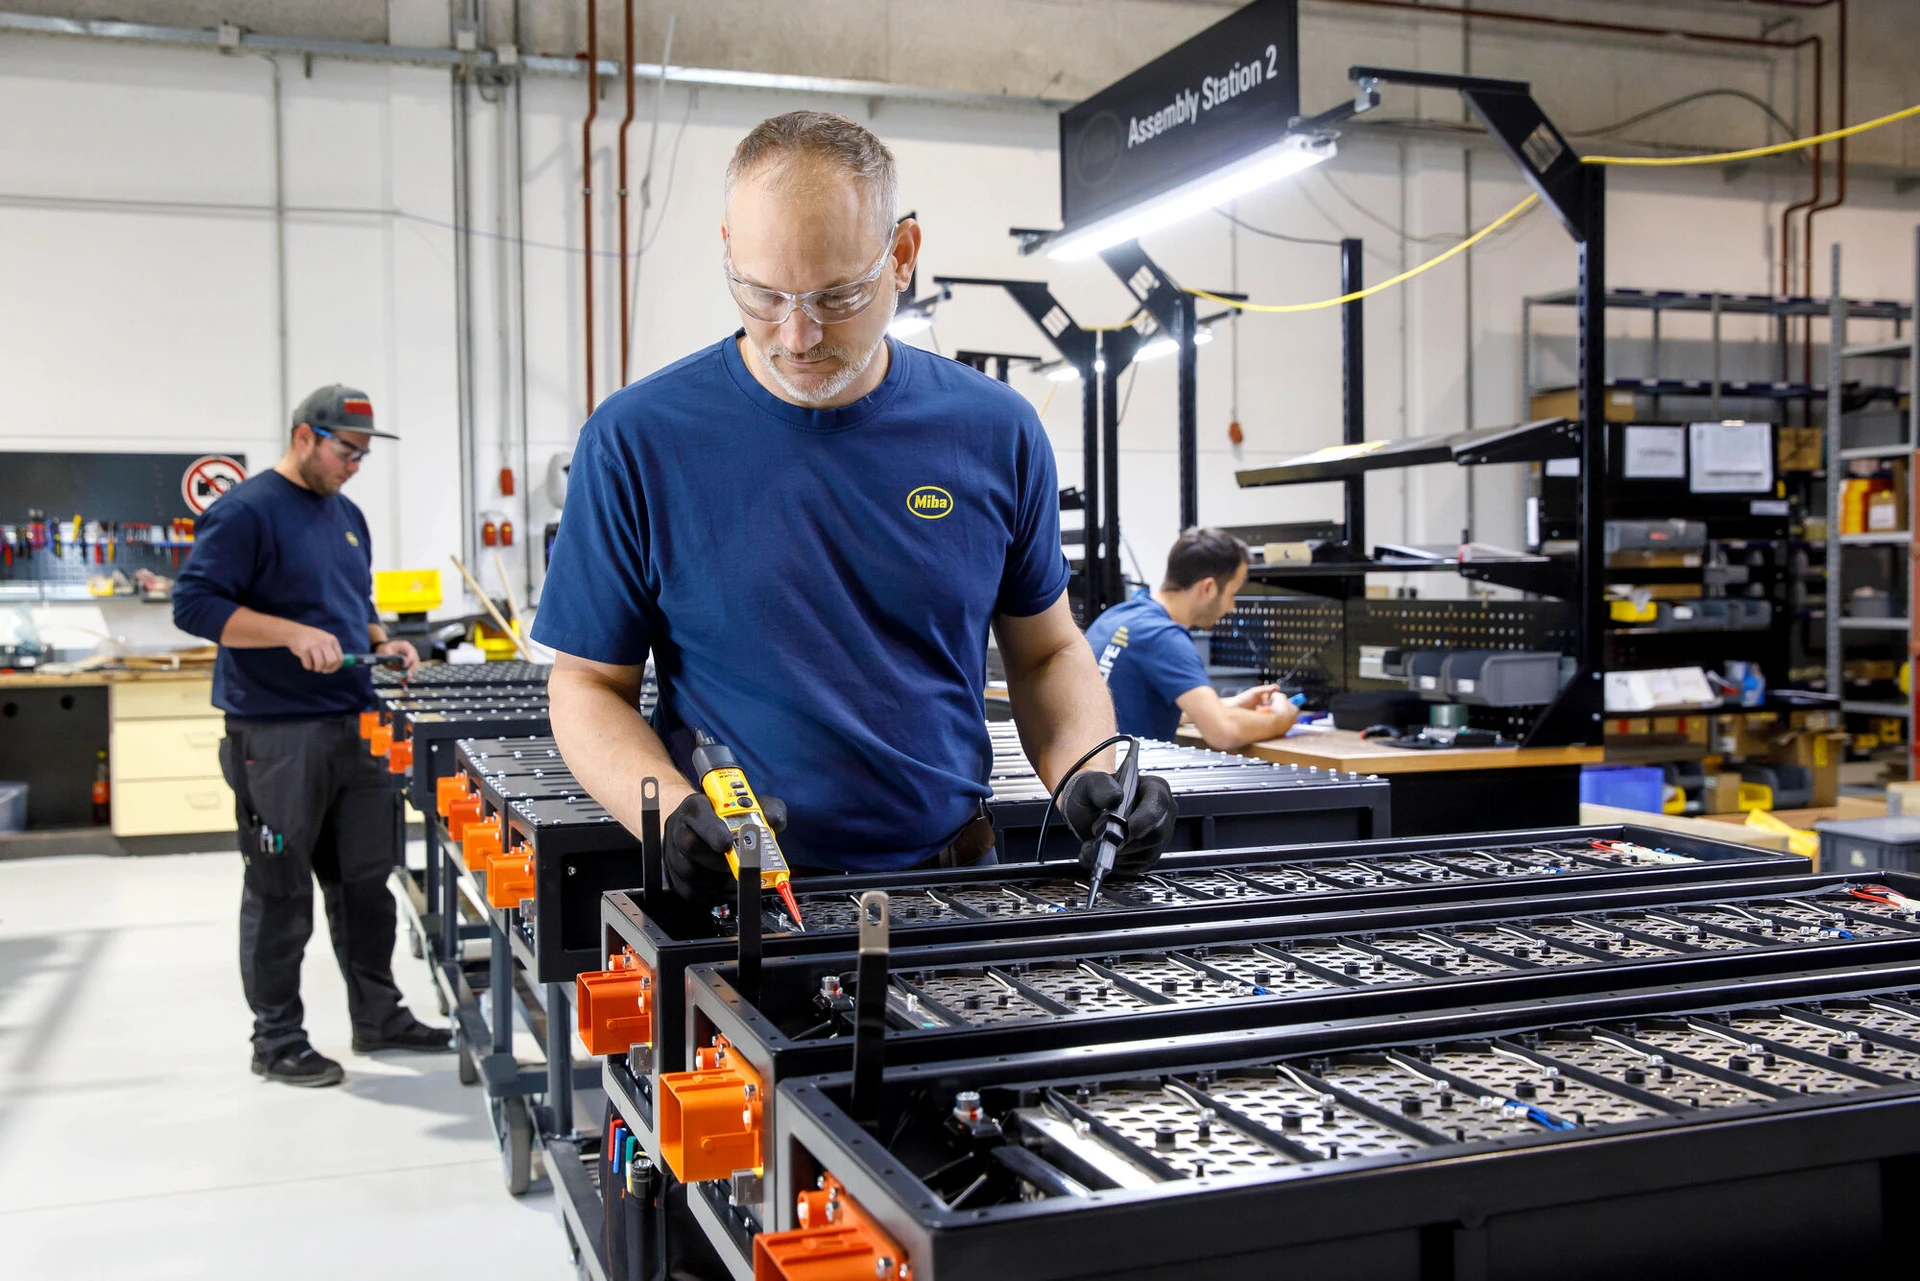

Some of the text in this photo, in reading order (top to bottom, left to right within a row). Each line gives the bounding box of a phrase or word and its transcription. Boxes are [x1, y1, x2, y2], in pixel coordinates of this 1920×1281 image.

[1127, 44, 1278, 148] Assembly Station 2
[914, 495, 947, 508] Miba
